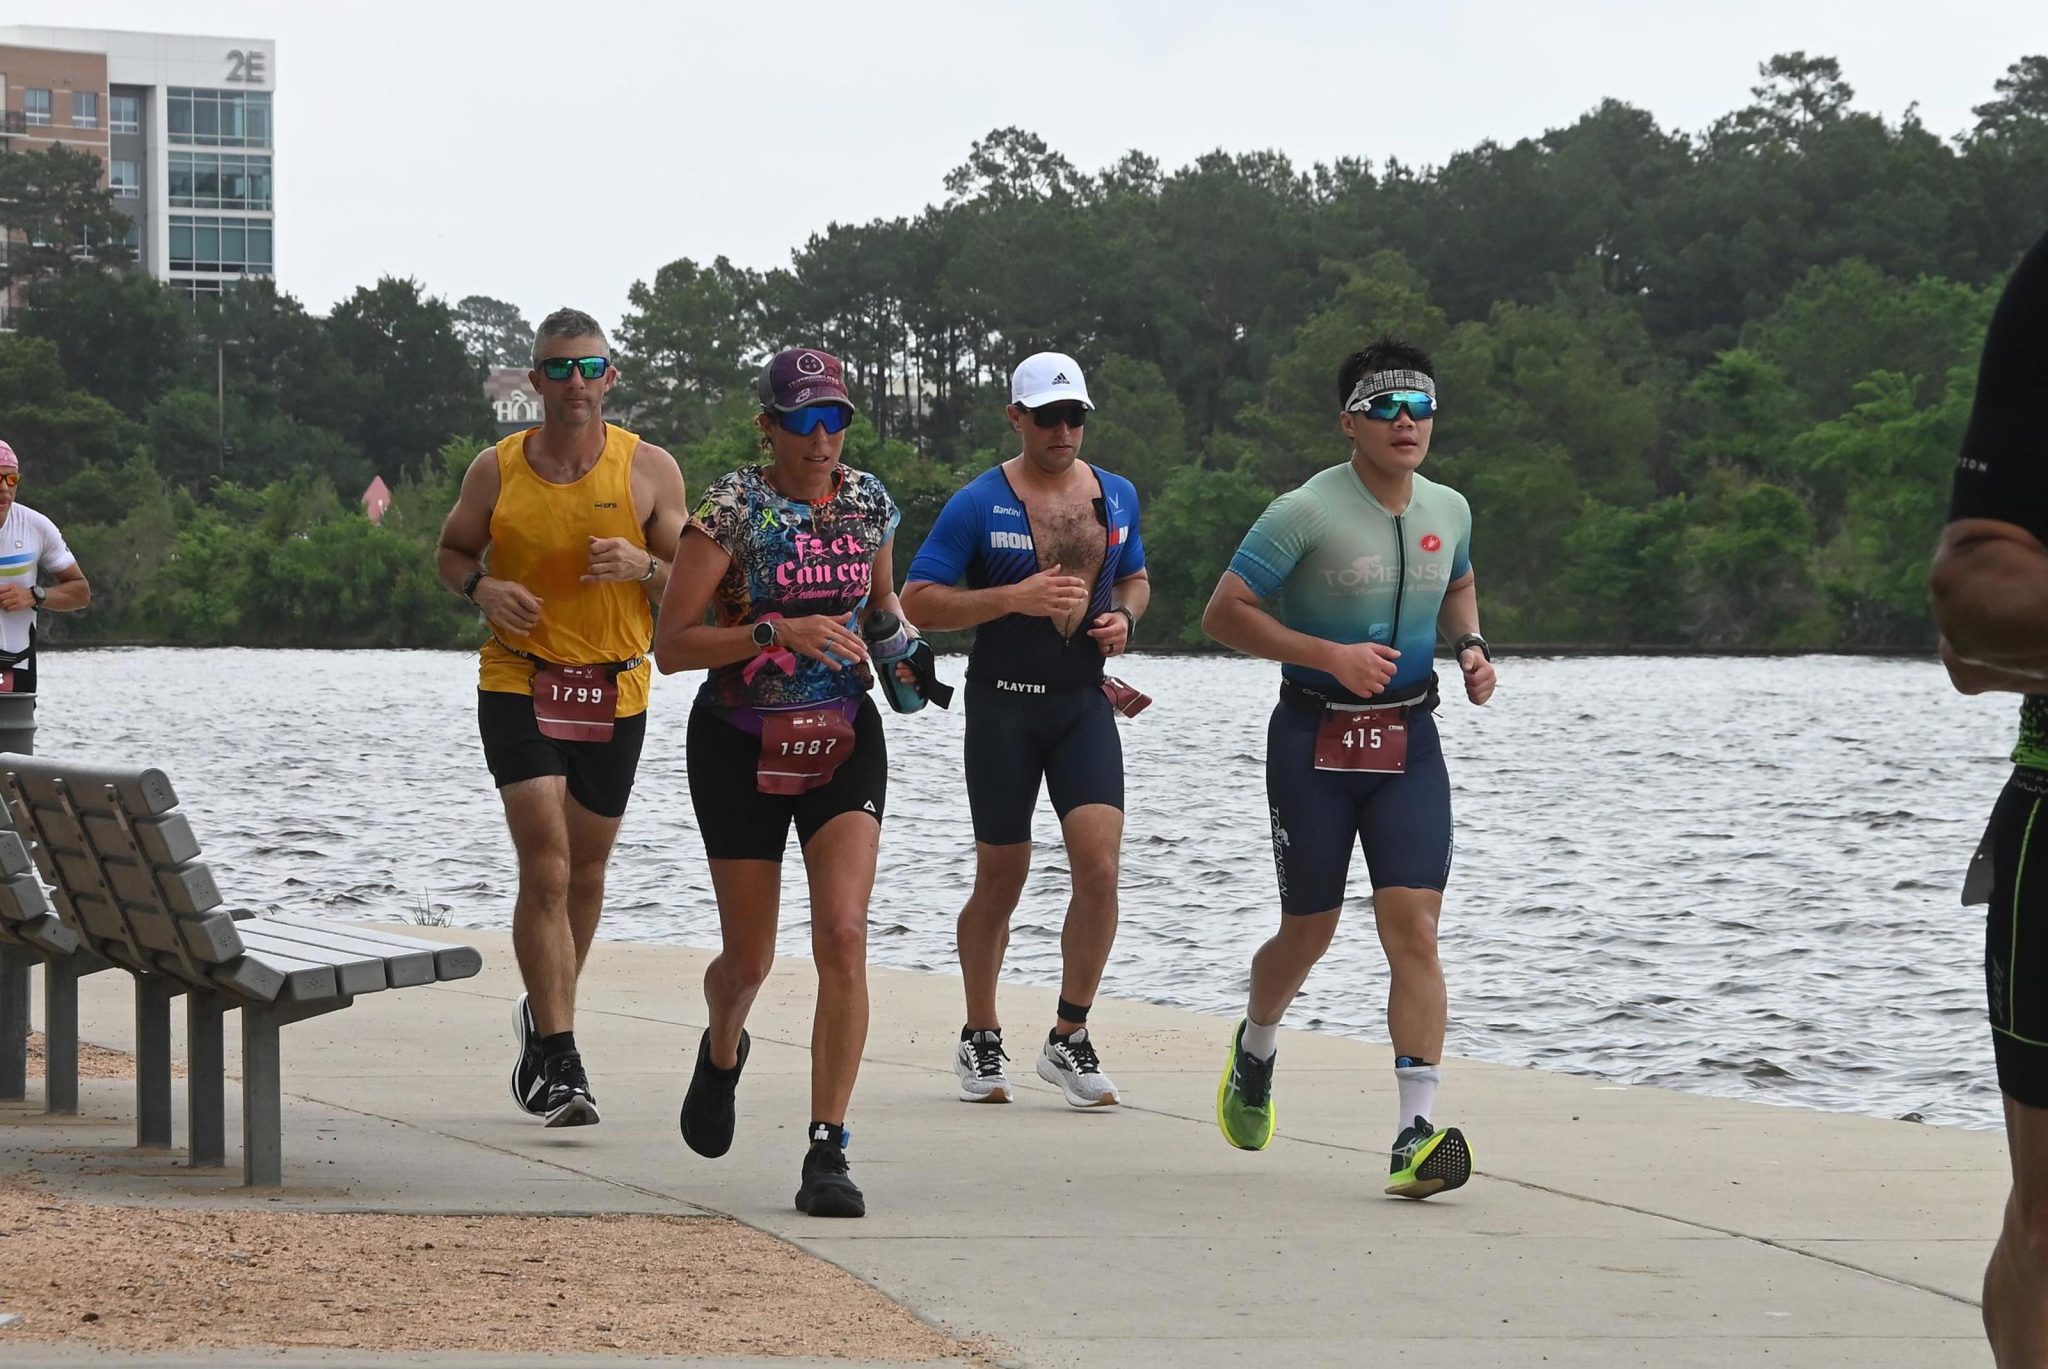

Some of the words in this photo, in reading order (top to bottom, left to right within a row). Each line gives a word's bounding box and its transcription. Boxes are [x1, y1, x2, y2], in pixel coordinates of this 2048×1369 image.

[225, 48, 266, 83] 2E
[992, 505, 1021, 518] Santini
[794, 533, 866, 564] Fck
[990, 531, 1034, 551] IRON
[776, 560, 870, 586] Cancer
[1318, 563, 1450, 587] TOMENS
[551, 684, 603, 704] 1799
[996, 679, 1046, 694] PLAYTRI
[781, 738, 837, 756] 1987
[1342, 728, 1382, 749] 415
